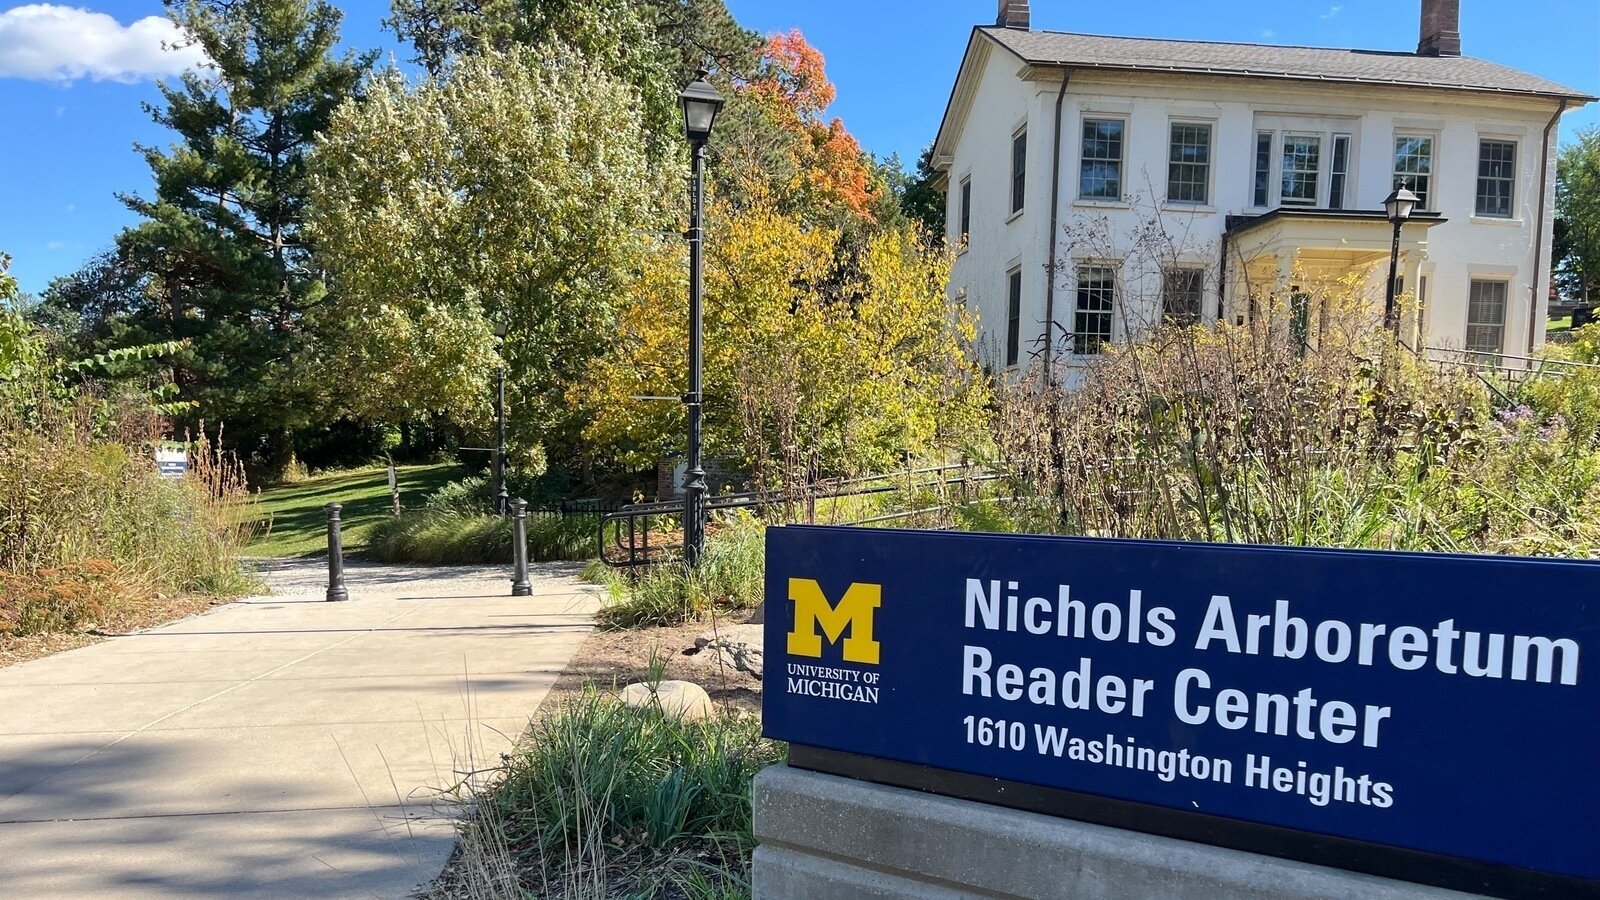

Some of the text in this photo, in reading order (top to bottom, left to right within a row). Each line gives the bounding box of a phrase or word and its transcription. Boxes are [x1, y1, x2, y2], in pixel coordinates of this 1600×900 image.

[786, 577, 882, 666] M
[964, 578, 1579, 686] Nichols Arboretum
[786, 663, 880, 685] UNIVERSITY OF
[786, 677, 880, 705] MICHIGAN
[962, 644, 1392, 750] Reader Center
[963, 715, 1395, 809] 1610 Washington Heights
